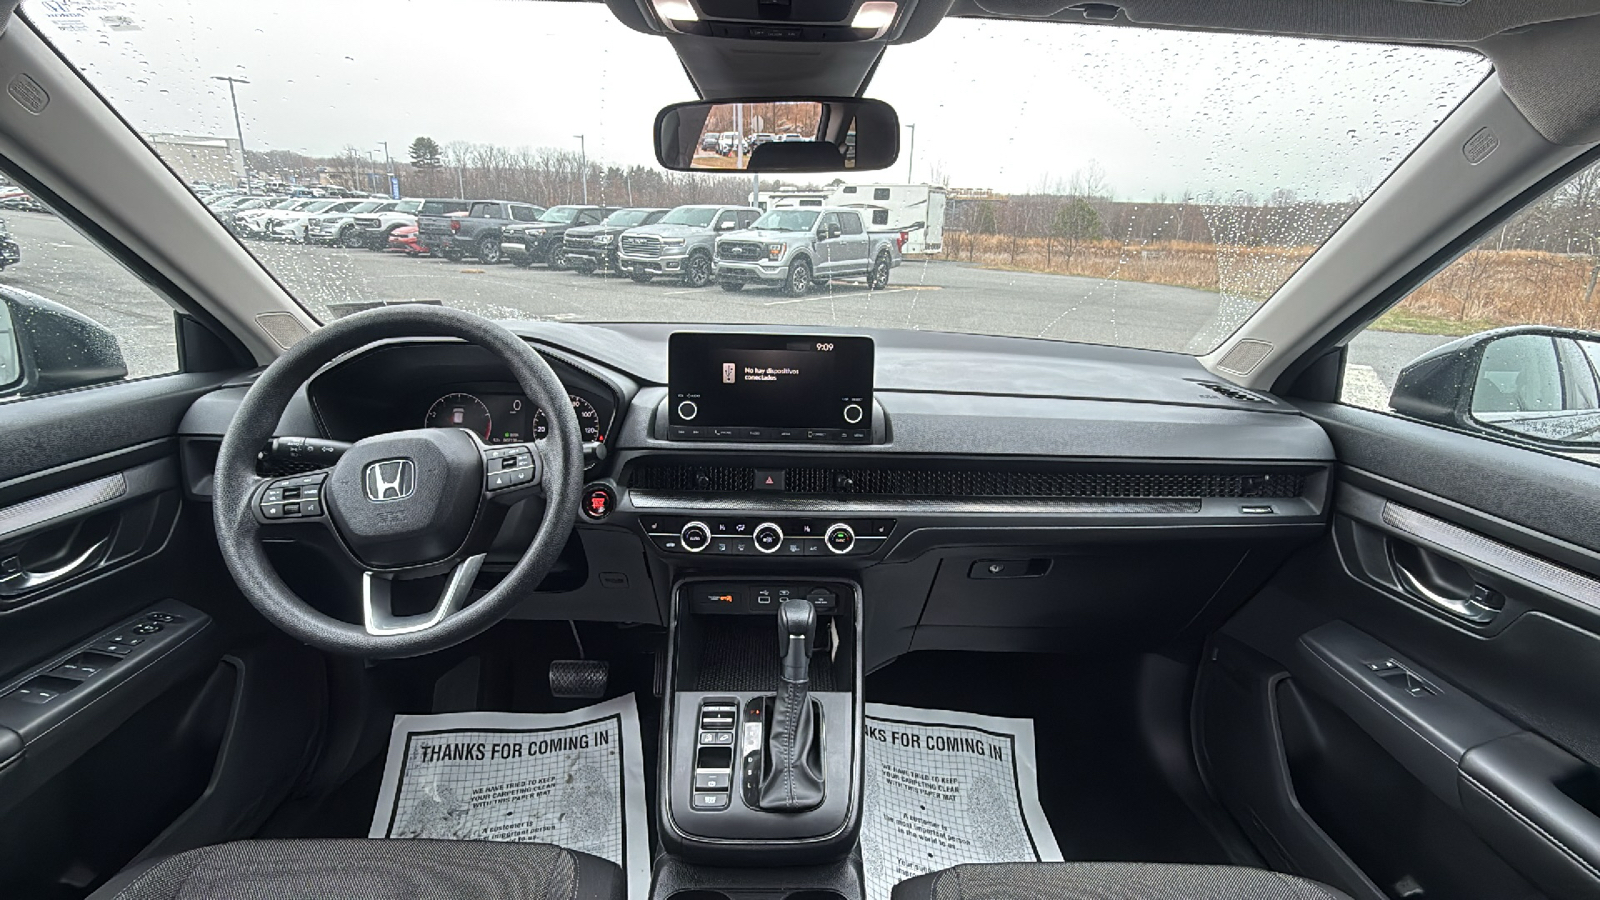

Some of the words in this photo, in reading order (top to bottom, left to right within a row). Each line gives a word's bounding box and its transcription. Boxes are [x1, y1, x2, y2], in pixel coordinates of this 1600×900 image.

[816, 342, 834, 351] 9:09
[754, 367, 766, 375] hay
[766, 367, 799, 375] dispositivos
[420, 743, 486, 763] THANKS
[490, 743, 523, 761] FOR
[527, 734, 589, 757] COMING
[594, 730, 609, 747] IN
[891, 731, 921, 749] FOR
[926, 735, 986, 756] COMING
[989, 743, 1003, 761] IN
[472, 787, 484, 795] WE
[485, 784, 504, 792] HAVE
[492, 787, 532, 799] CARPETING
[533, 783, 556, 791] CLEAN
[512, 792, 535, 802] PAPER
